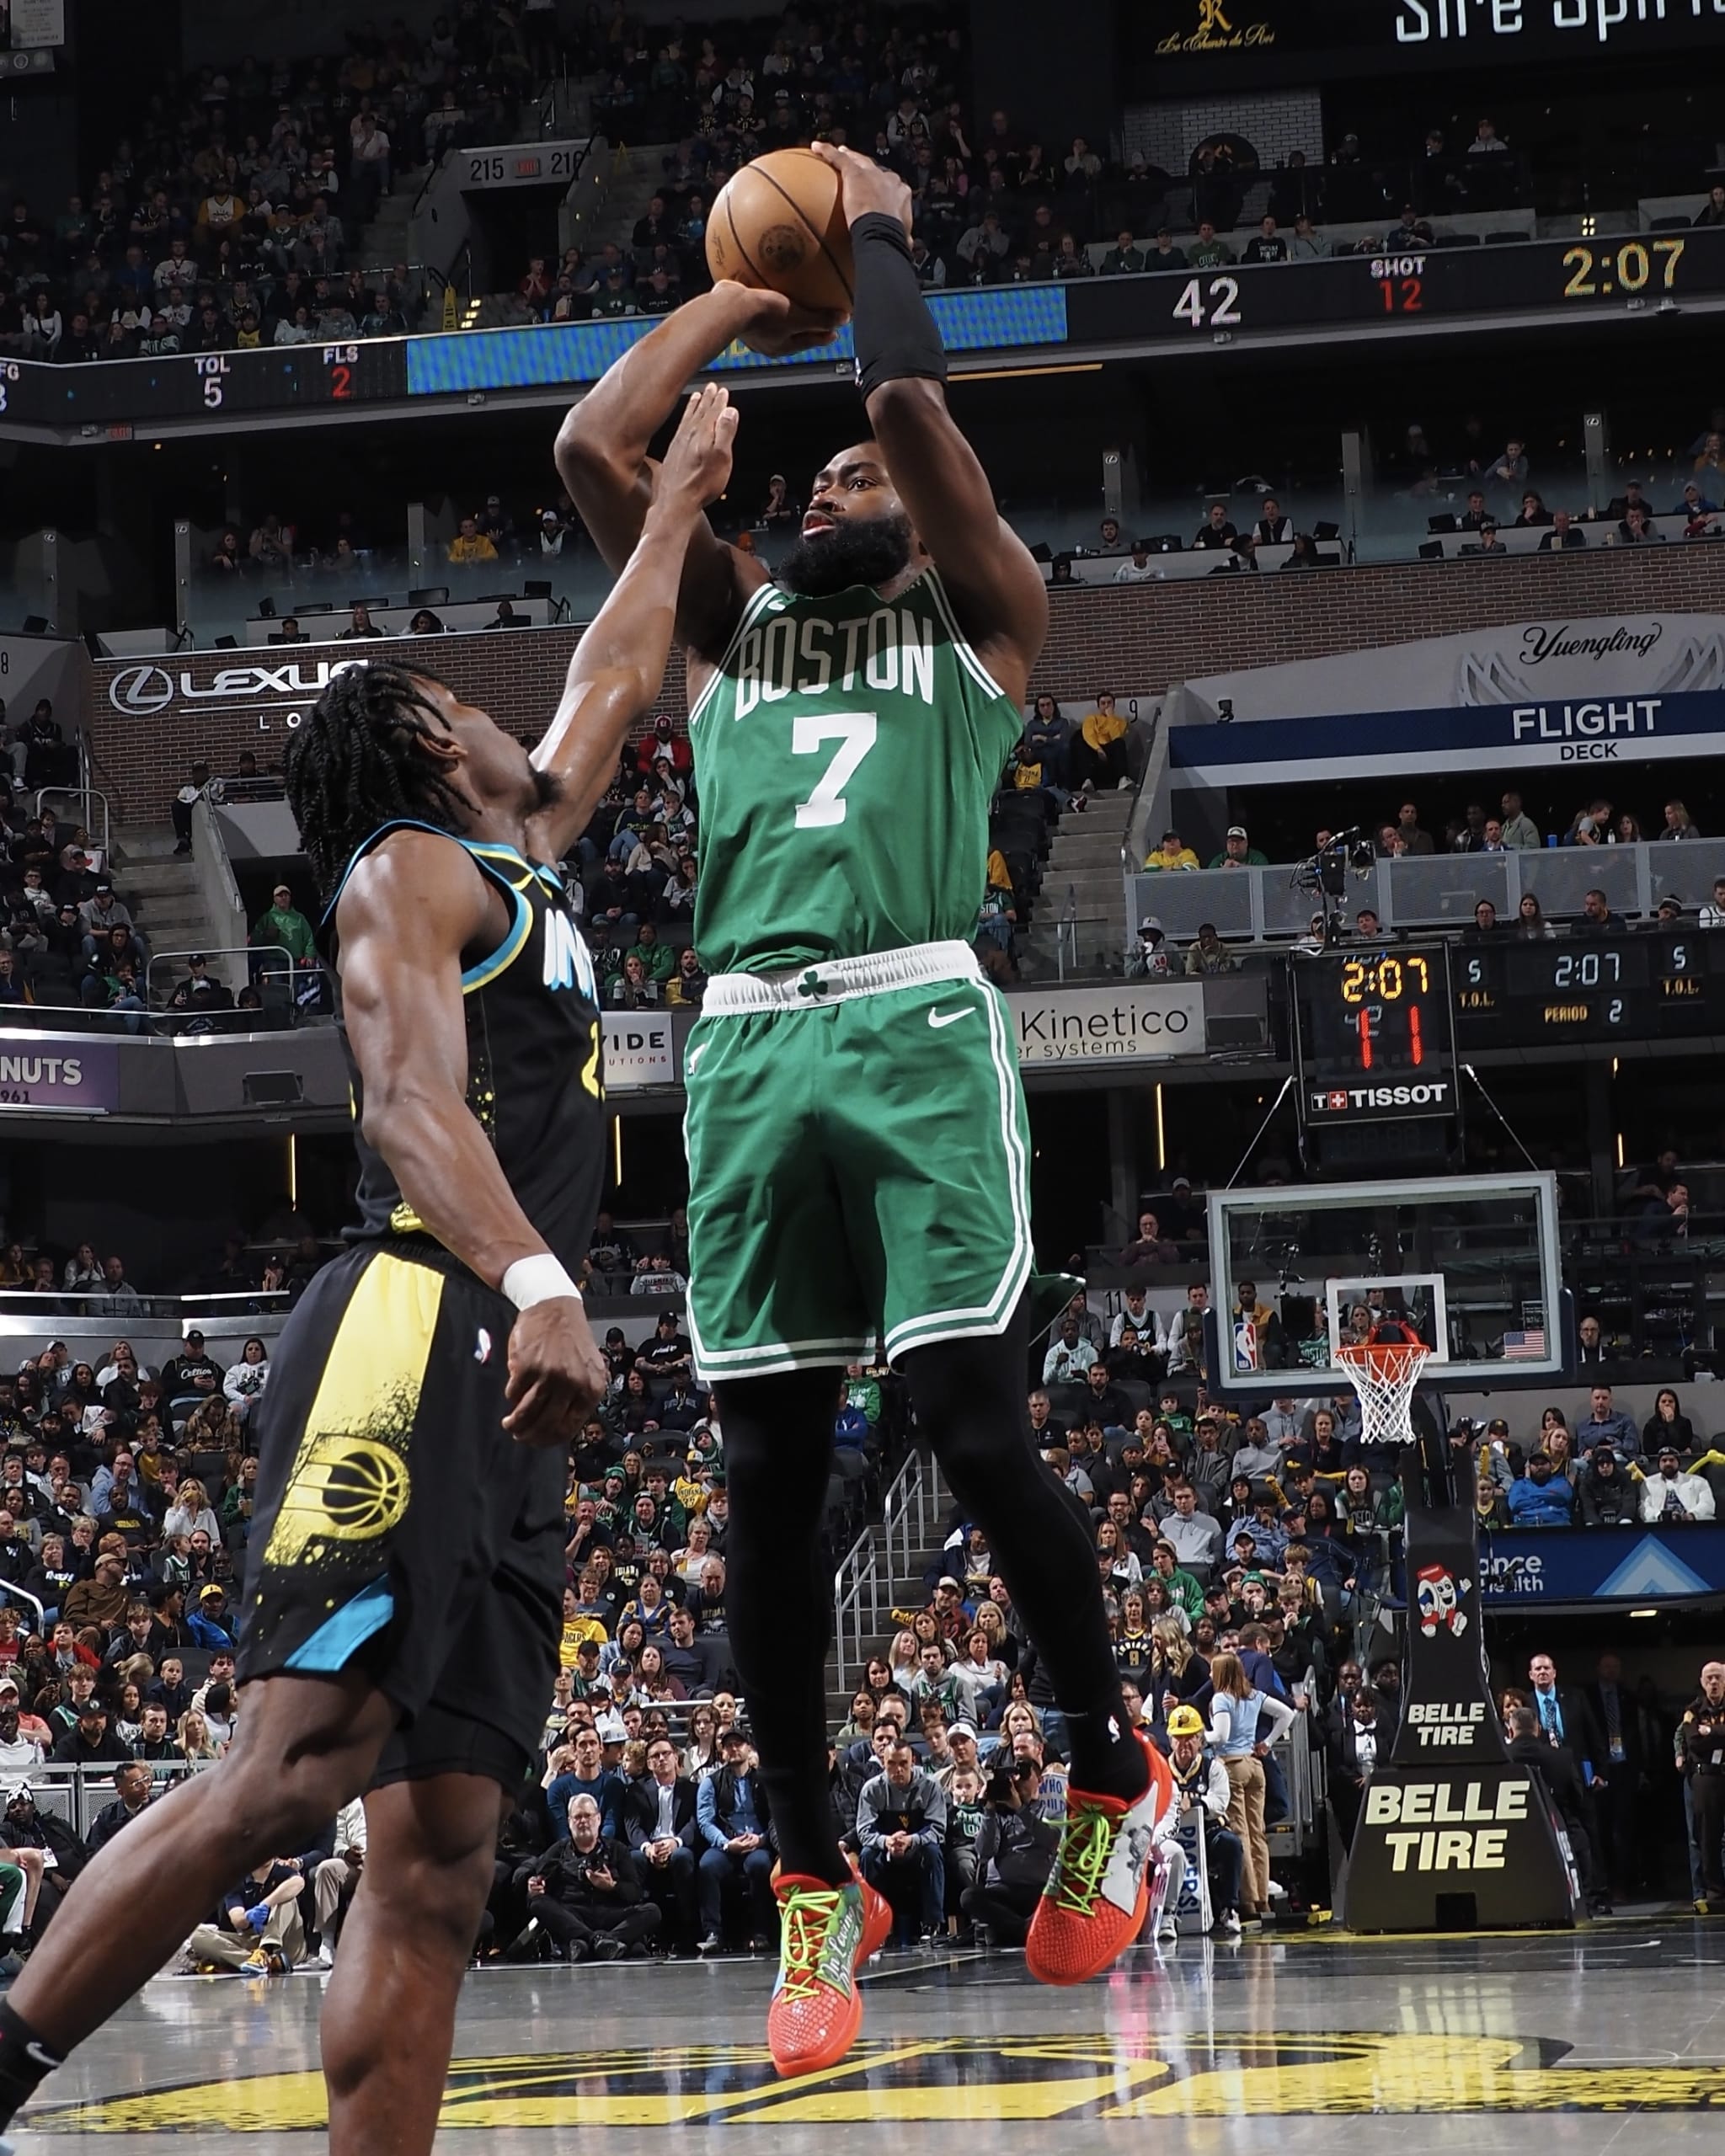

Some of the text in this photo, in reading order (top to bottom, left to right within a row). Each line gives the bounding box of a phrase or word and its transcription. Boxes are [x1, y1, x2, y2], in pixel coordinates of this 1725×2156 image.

[470, 157, 504, 181] 215
[1370, 256, 1426, 279] SHOT
[1562, 239, 1685, 297] 2:07
[1172, 276, 1242, 328] 42
[1380, 279, 1423, 312] 12
[194, 356, 230, 375] TOL
[323, 346, 359, 365] FLS
[204, 376, 222, 408] 5
[331, 366, 351, 398] 2
[1519, 622, 1663, 665] Yuengling
[734, 608, 934, 722] BOSTON
[1129, 698, 1138, 723] 9
[1512, 699, 1663, 740] FLIGHT
[1560, 742, 1619, 761] DECK
[792, 712, 877, 829] 7
[1468, 959, 1482, 984] 5
[1555, 952, 1621, 987] 2:07
[1673, 945, 1685, 970] 5
[1343, 957, 1429, 1003] 2:07
[1020, 1005, 1188, 1042] Kinetico
[1544, 1005, 1588, 1023] PERIOD
[1609, 999, 1623, 1023] 2
[603, 1032, 665, 1051] IDE
[1044, 1038, 1137, 1059] systems
[1359, 1005, 1423, 1070] 11
[0, 1055, 83, 1086] NUTS
[608, 1055, 668, 1066] UTIONS
[1348, 1083, 1448, 1108] TISSOT
[1104, 1291, 1122, 1319] 11
[1407, 1702, 1485, 1724] BELLE
[1417, 1725, 1475, 1746] TIRE
[1365, 1780, 1530, 1825] BELLE
[1385, 1829, 1508, 1871] TIRE
